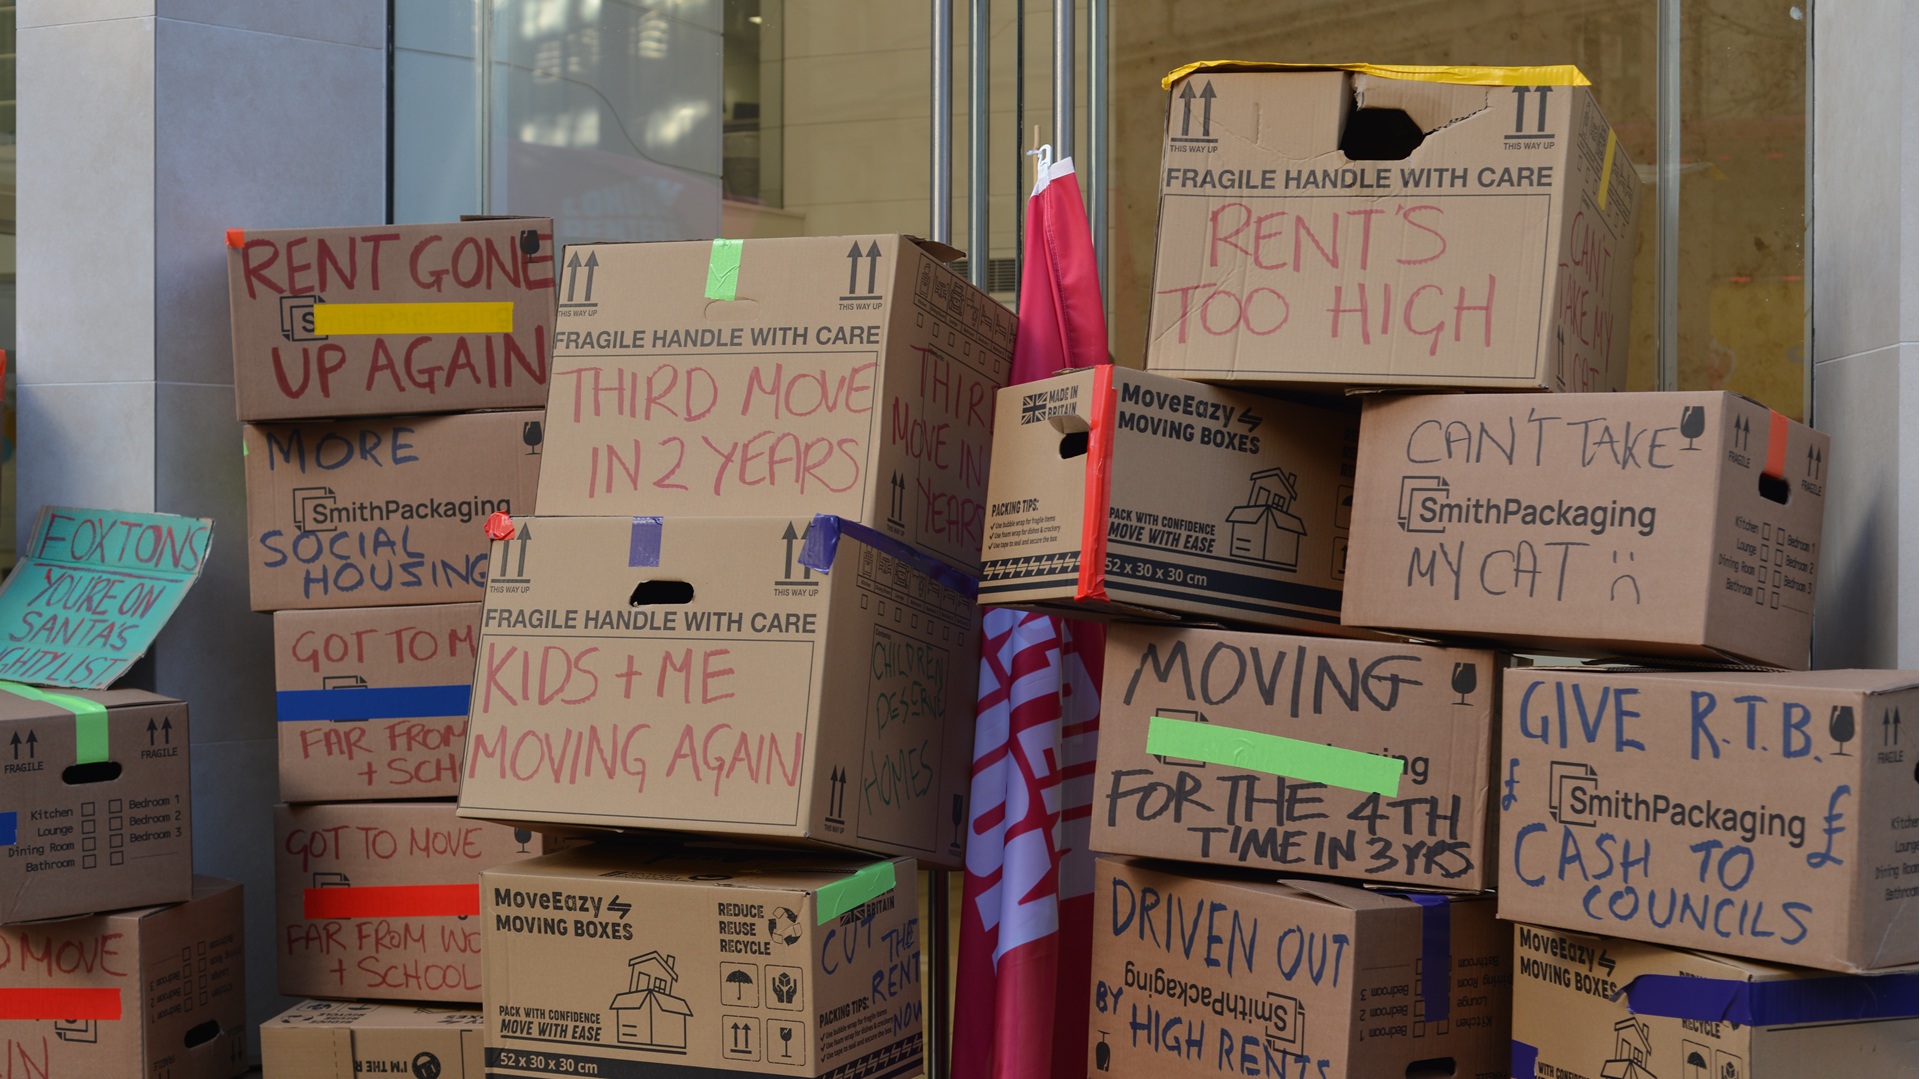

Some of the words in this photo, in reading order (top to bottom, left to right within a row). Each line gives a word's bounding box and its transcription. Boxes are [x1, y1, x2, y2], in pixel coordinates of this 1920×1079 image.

[1170, 145, 1187, 153] THIS
[1188, 145, 1206, 153] WAY
[1207, 145, 1218, 154] UP
[1166, 168, 1276, 189] FRAGILE
[1285, 169, 1391, 189] HANDLE
[1400, 168, 1467, 188] WITH
[1478, 166, 1553, 188] CARE
[1209, 203, 1446, 272] RENT'S
[242, 233, 400, 299] RENT
[409, 231, 555, 291] GONE
[839, 303, 853, 311] THIS
[873, 302, 882, 310] UP
[1157, 283, 1289, 344] TOO
[1327, 274, 1495, 356] HIGH
[554, 329, 646, 349] FRAGILE
[652, 328, 744, 348] HANDLE
[751, 327, 808, 346] WITH
[815, 325, 880, 345] CARE
[271, 342, 347, 399] UP
[366, 325, 547, 394] AGAIN
[552, 364, 718, 423] THIRD
[741, 362, 879, 419] MOVE
[911, 344, 1002, 436] THIRD
[1048, 402, 1077, 418] BRITAIN
[1049, 387, 1069, 404] MADE
[1070, 385, 1078, 399] IN
[1121, 382, 1237, 428] MoveEazy
[266, 427, 420, 473] MORE
[892, 396, 950, 470] MOVE
[959, 439, 983, 489] IN
[1118, 411, 1195, 442] MOVING
[1200, 428, 1261, 455] BOXES
[1407, 407, 1562, 467] CAN'T
[1567, 418, 1678, 470] TAKE
[589, 439, 641, 498] IN
[653, 436, 689, 491] 2
[701, 430, 859, 496] YEARS
[312, 497, 511, 525] SmithPackaging
[916, 477, 986, 552] YEARS
[992, 501, 1021, 517] PACKING
[1022, 498, 1039, 513] TIPS:
[1032, 517, 1044, 525] fragile
[1109, 507, 1133, 522] PACK
[1136, 511, 1159, 527] WITH
[1162, 515, 1216, 536] CONFIDENCE
[1420, 497, 1656, 536] SmithPackaging
[1735, 516, 1759, 534] Kitchen
[38, 514, 208, 571] FOXTONS
[259, 525, 425, 567] SOCIAL
[1108, 521, 1144, 542] MOVE
[1149, 528, 1181, 549] WITH
[1184, 536, 1216, 554] EASE
[1737, 539, 1757, 556] Lounge
[304, 553, 488, 599] HOUSING
[1408, 541, 1464, 601] MY
[1480, 540, 1591, 601] CAT
[1726, 578, 1753, 596] Bathroom
[118, 583, 166, 619] ON
[791, 589, 807, 597] WAY
[809, 589, 819, 597] UP
[9, 611, 139, 651] SANTA'S
[484, 608, 578, 629] FRAGILE
[584, 610, 677, 631] HANDLE
[684, 612, 743, 632] WITH
[750, 613, 817, 633] CARE
[292, 629, 379, 672] GOT
[385, 626, 438, 664] TO
[873, 641, 943, 688] CHILDREN
[482, 642, 599, 714] KIDS
[615, 655, 642, 699] +
[657, 648, 735, 704] ME
[1123, 640, 1423, 718] MOVING
[299, 727, 374, 761] FAR
[384, 720, 468, 752] FROM
[1520, 681, 1646, 752] GIVE
[1691, 690, 1823, 763] R.T.B.
[4, 761, 44, 773] FRAGILE
[141, 747, 178, 759] FRAGILE
[469, 723, 651, 793] MOVING
[666, 723, 802, 797] AGAIN
[864, 739, 933, 815] HOMES
[1502, 758, 1520, 811] £
[31, 808, 73, 821] Kitchen
[129, 797, 170, 809] Bedroom
[130, 813, 170, 826] Bedroom
[175, 811, 181, 821] 2
[1106, 769, 1214, 826] FOR
[1217, 775, 1329, 826] THE
[1347, 792, 1461, 840] 4TH
[1570, 786, 1806, 848] SmithPackaging
[38, 825, 73, 837] Lounge
[130, 829, 171, 843] Bedroom
[175, 827, 181, 837] 3
[1806, 785, 1851, 869] £
[9, 846, 44, 858] Dining
[50, 841, 74, 852] Room
[26, 858, 75, 872] Bathroom
[286, 825, 350, 872] GOT
[356, 827, 397, 860] TO
[410, 827, 483, 859] MOVE
[1187, 825, 1307, 864] TIME
[1314, 830, 1356, 869] IN
[1365, 836, 1399, 873] 3
[1402, 840, 1474, 878] YRS
[1514, 823, 1651, 887] CASH
[1690, 839, 1754, 892] TO
[495, 888, 603, 918] MoveEazy
[718, 903, 764, 919] REDUCE
[1583, 885, 1813, 945] COUNCILS
[286, 922, 346, 955] FAR
[357, 920, 426, 954] FROM
[496, 915, 568, 936] MOVING
[574, 919, 633, 941] BOXES
[719, 921, 756, 936] REUSE
[720, 939, 771, 956] RECYCLE
[821, 914, 875, 975] CUT
[881, 918, 918, 963] THE
[1112, 877, 1257, 978] DRIVEN
[1277, 925, 1350, 988] OUT
[1520, 926, 1595, 966] MoveEazy
[20, 932, 128, 977] MOVE
[357, 956, 482, 990] SCHOOL
[872, 950, 921, 1005] RENT
[1125, 961, 1288, 1032] SmithPackaging
[1520, 955, 1571, 988] MOVING
[1575, 974, 1617, 1000] BOXES
[500, 1005, 521, 1017] PACK
[524, 1007, 545, 1020] WITH
[549, 1009, 600, 1024] CONFIDENCE
[500, 1018, 533, 1036] MOVE
[538, 1022, 567, 1039] WITH
[571, 1025, 602, 1041] EASE
[1096, 980, 1123, 1015] BY
[1129, 1003, 1205, 1061] HIGH
[500, 1053, 516, 1066] 52
[530, 1055, 545, 1069] 30
[560, 1058, 574, 1072] 30
[578, 1063, 598, 1074] cm
